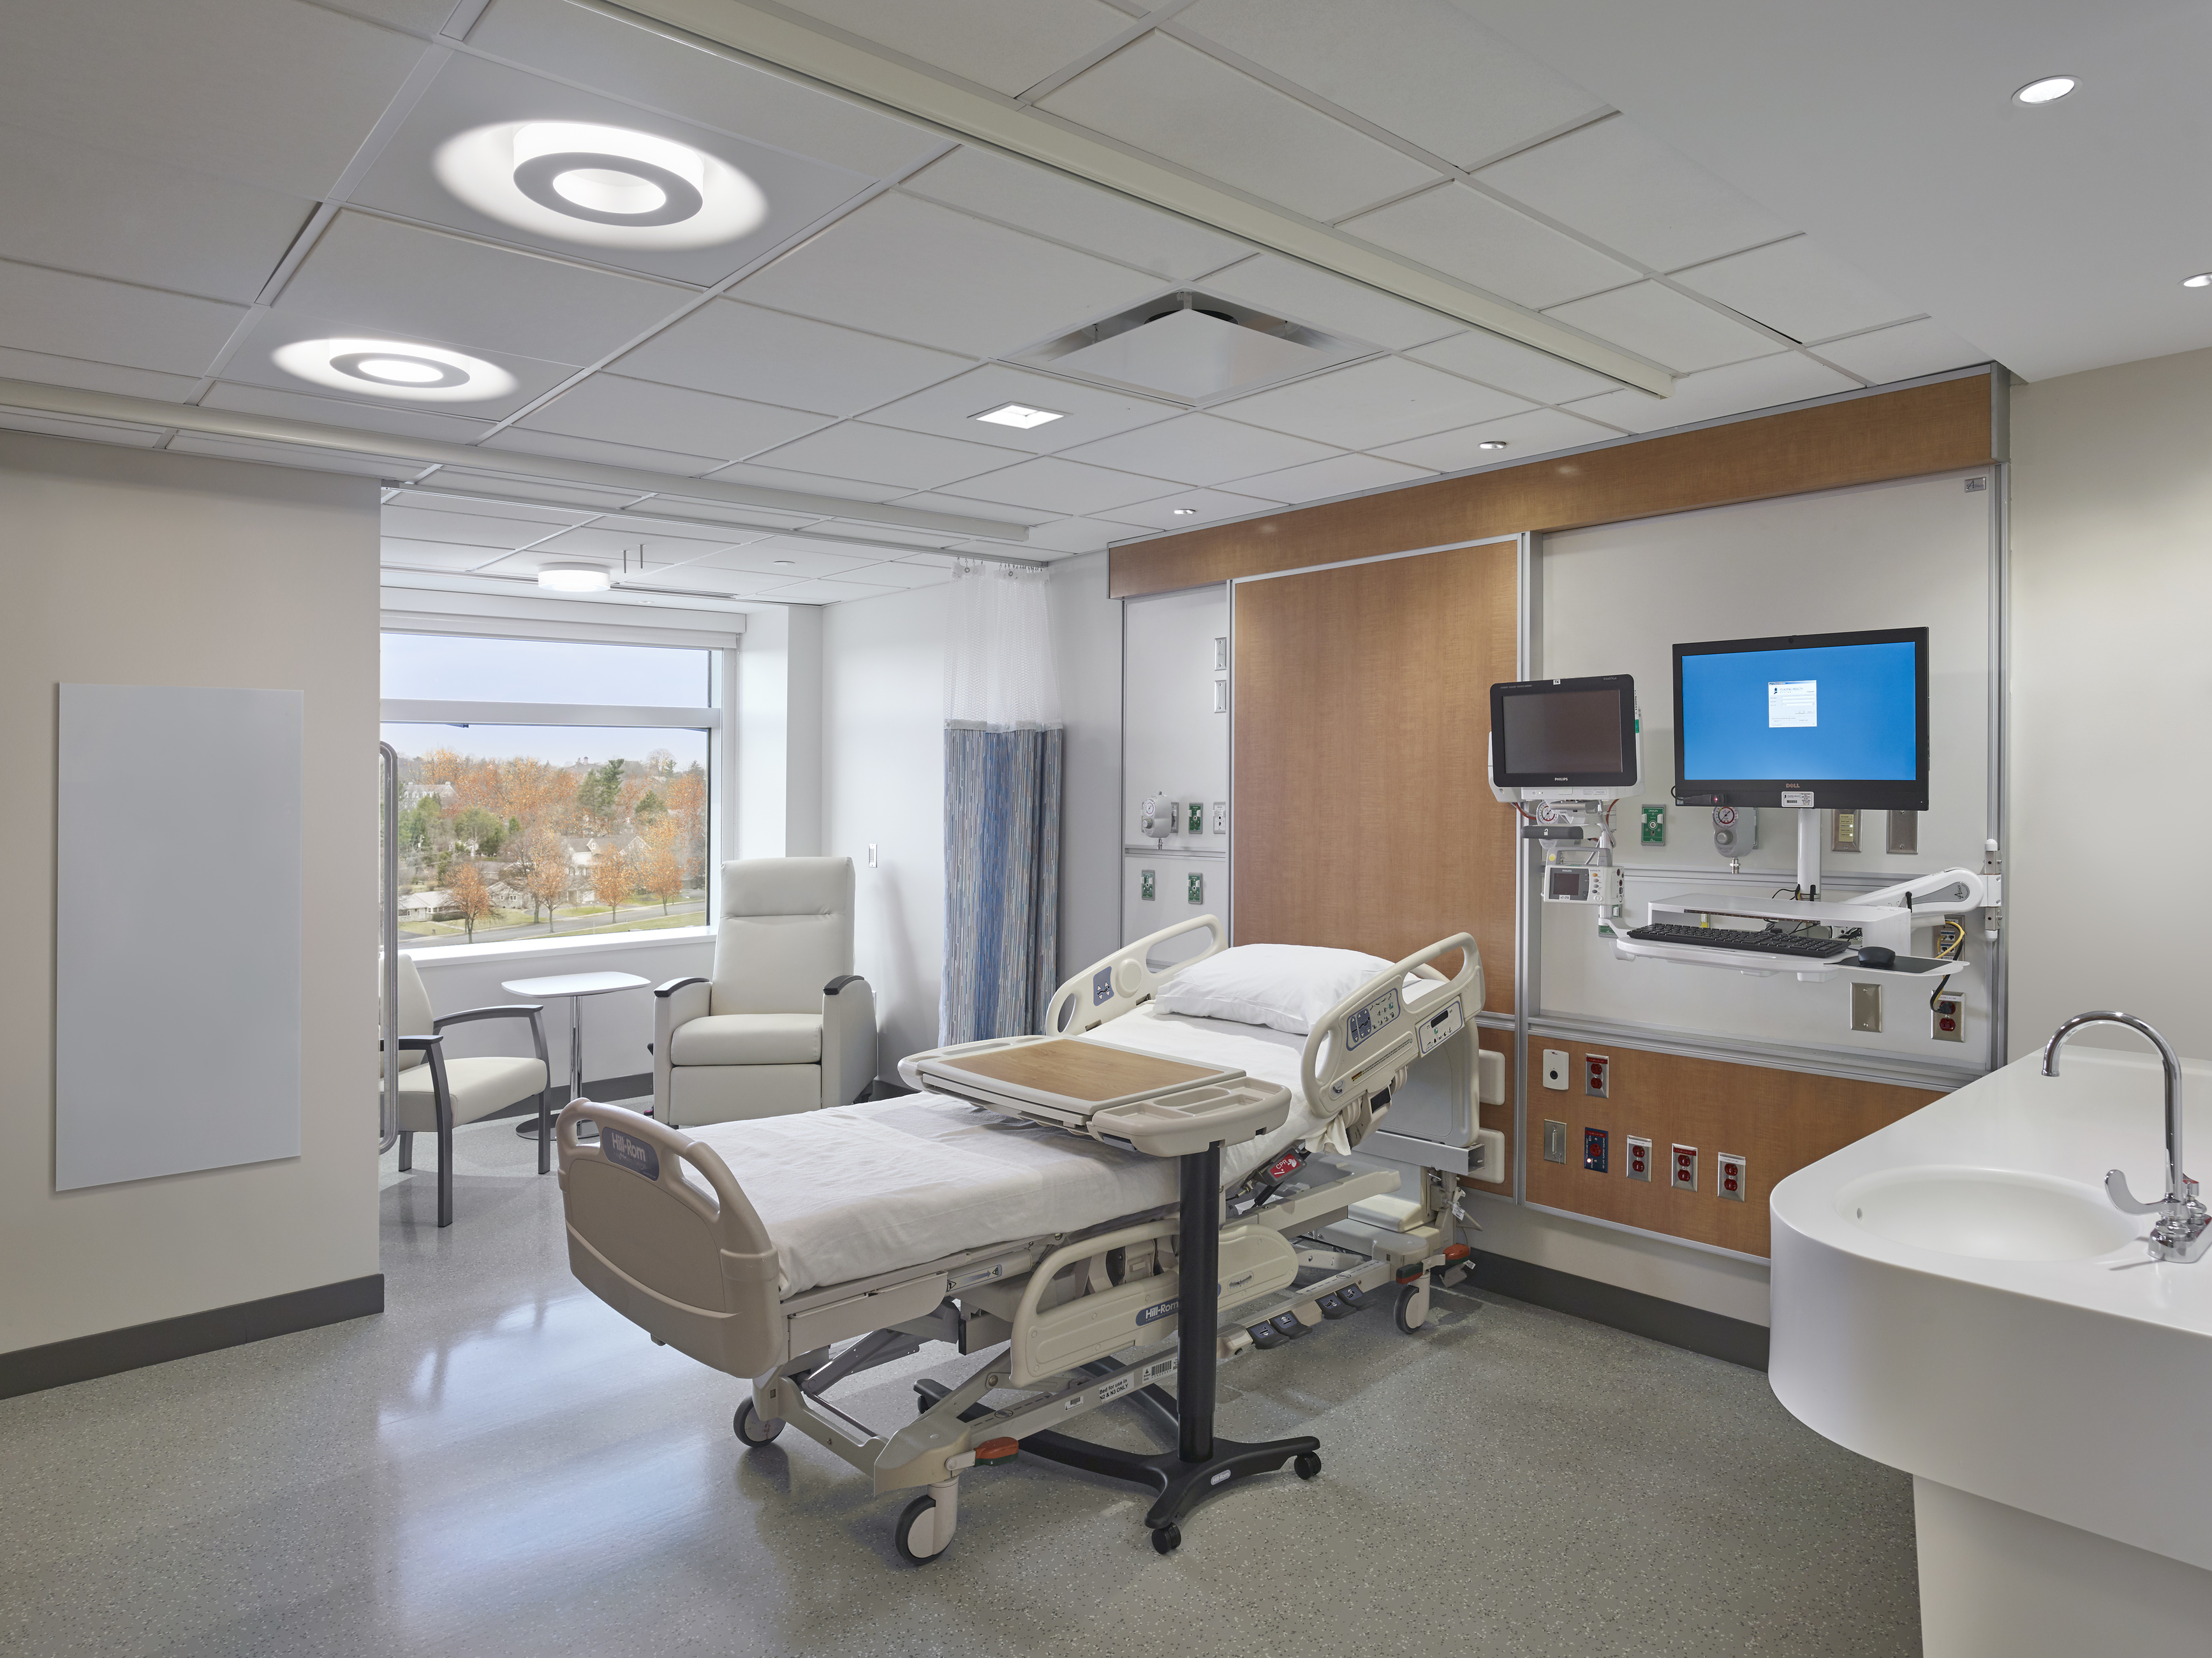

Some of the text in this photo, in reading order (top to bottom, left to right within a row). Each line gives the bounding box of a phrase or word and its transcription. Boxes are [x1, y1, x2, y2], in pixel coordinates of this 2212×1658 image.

[611, 1132, 646, 1162] Hill-Rom
[1276, 1159, 1288, 1169] CPR
[1146, 1301, 1179, 1319] Hill-Rom
[1116, 1384, 1128, 1393] ONLY
[1213, 1472, 1229, 1483] Hill-Rom
